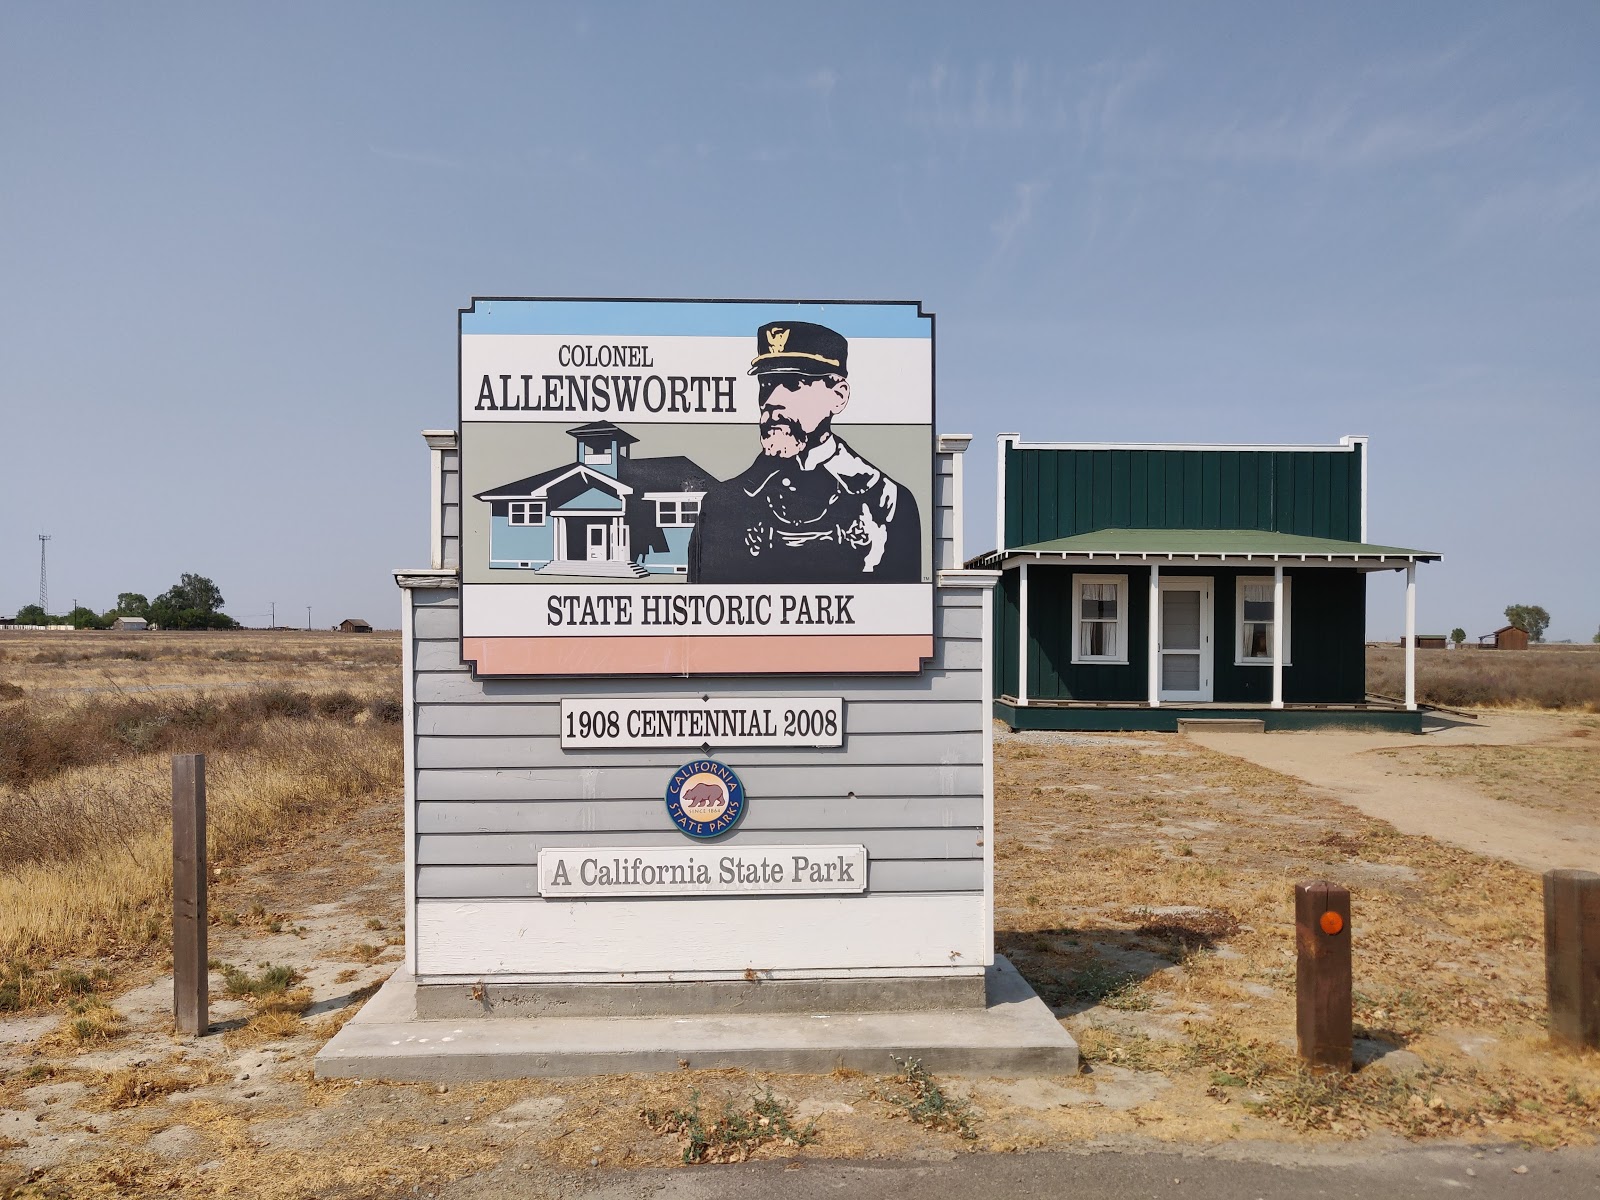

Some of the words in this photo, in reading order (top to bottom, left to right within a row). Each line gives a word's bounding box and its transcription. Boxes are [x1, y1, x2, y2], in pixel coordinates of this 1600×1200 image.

[558, 344, 654, 368] COLONEL
[474, 374, 737, 413] ALLENSWORTH
[547, 595, 632, 626] STATE
[641, 594, 772, 626] HISTORIC
[779, 594, 855, 625] PARK
[566, 710, 620, 738] 1908
[627, 709, 777, 738] CENTENNIAL
[784, 709, 838, 736] 2008
[670, 762, 738, 794] CALIFORNIA
[670, 802, 703, 833] STATE
[709, 801, 739, 832] PARKS
[551, 859, 572, 886] A
[580, 858, 711, 886] California
[719, 856, 784, 884] State
[792, 856, 855, 883] Park
